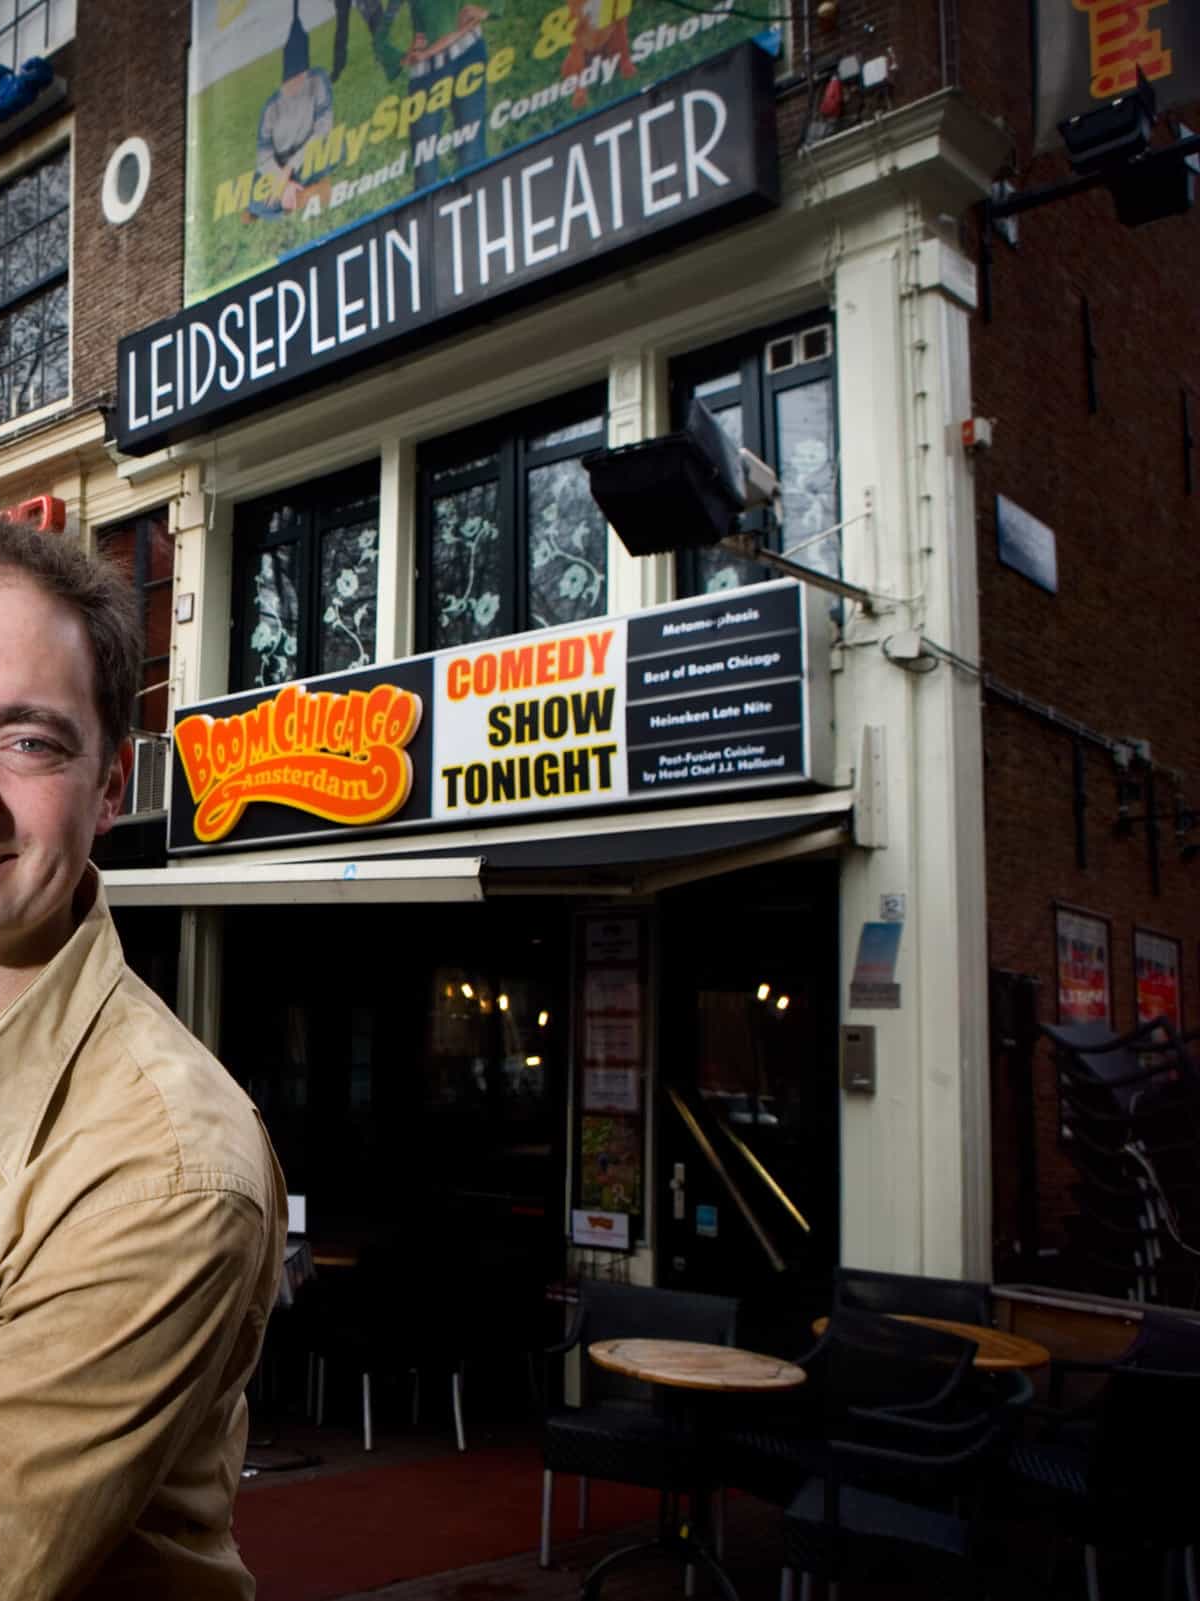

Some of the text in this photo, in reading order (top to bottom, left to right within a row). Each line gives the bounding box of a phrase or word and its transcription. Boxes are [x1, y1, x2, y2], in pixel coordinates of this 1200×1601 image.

[301, 47, 515, 180] MySpace
[533, 6, 578, 60] &
[302, 195, 321, 222] A
[330, 151, 407, 208] Brand
[414, 120, 480, 167] New
[490, 53, 621, 130] Comedy
[128, 89, 731, 431] LEIDSEPLEIN THEATER
[446, 630, 614, 702] COMEDY
[643, 652, 781, 684] Best of Boom Chicago
[175, 684, 416, 804] BOOM CHICAGO
[488, 687, 616, 748] SHOW
[650, 701, 772, 728] Heineken Late Nite
[224, 765, 387, 801] Amsterdam
[441, 744, 617, 808] TONIGHT
[642, 771, 656, 784] by
[659, 767, 688, 780] Head
[690, 763, 716, 776] Chef
